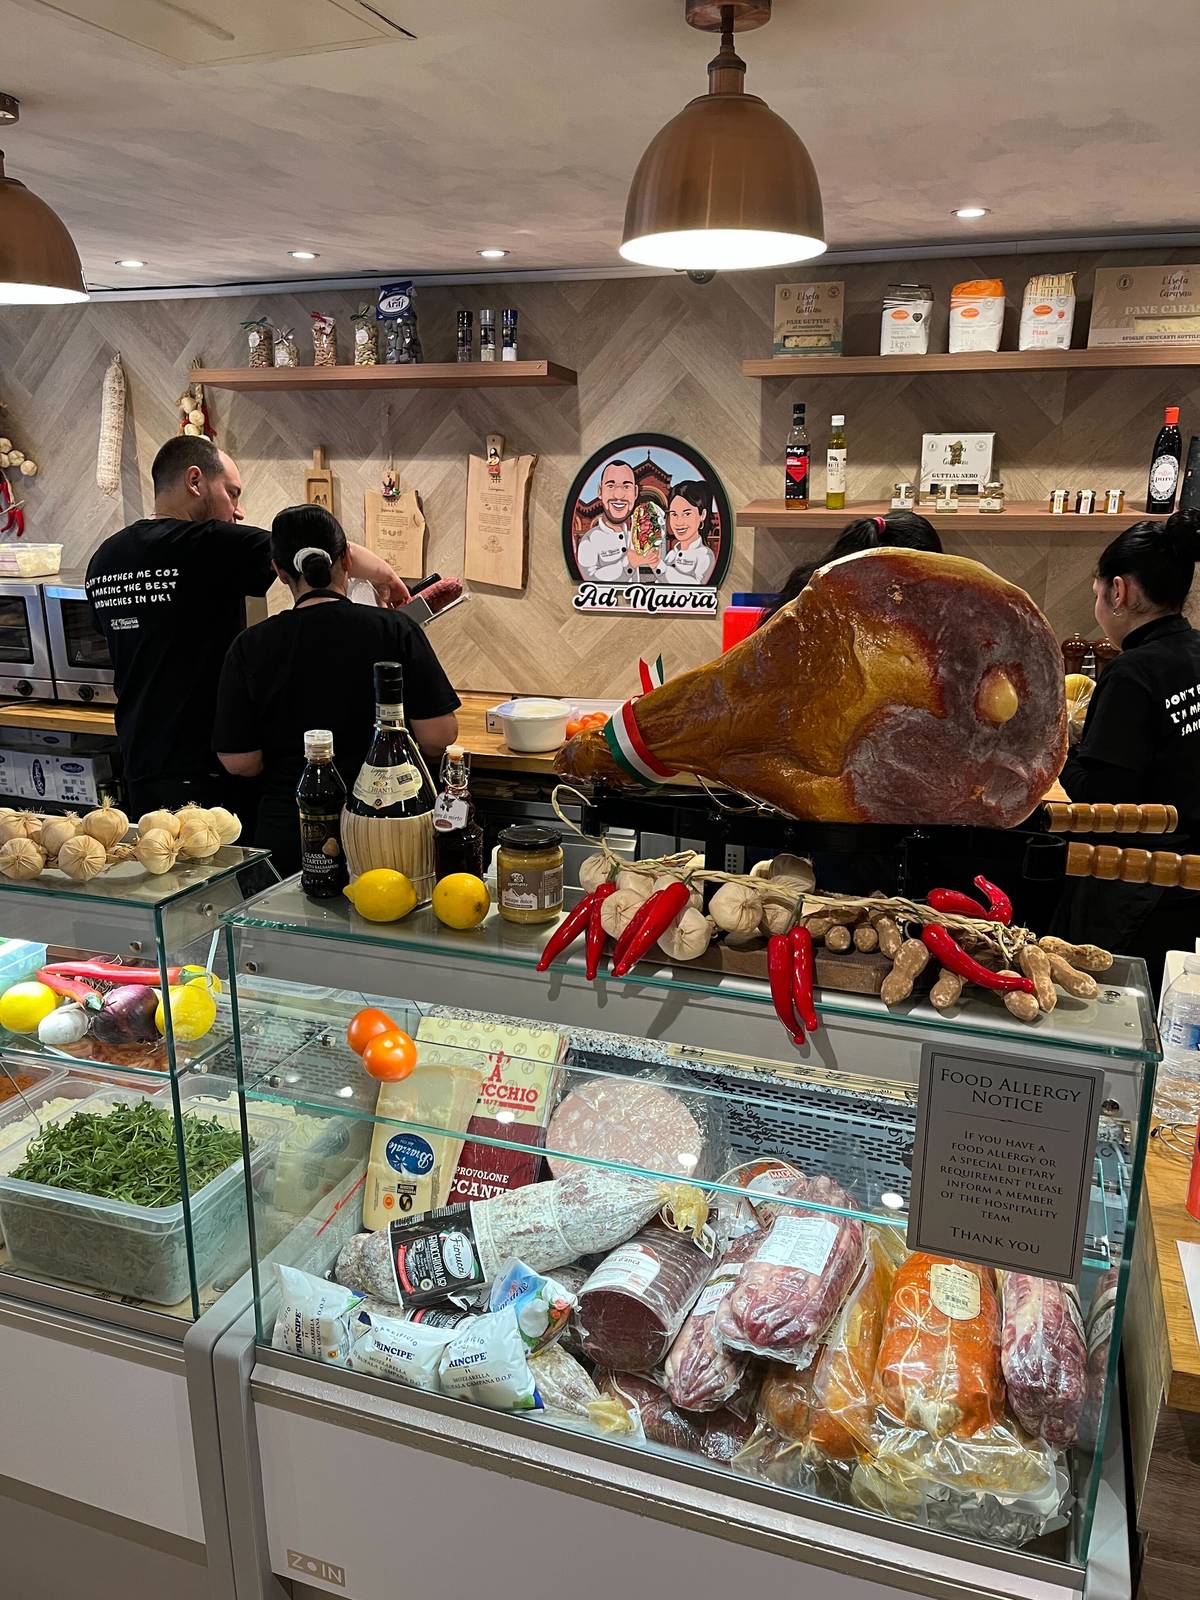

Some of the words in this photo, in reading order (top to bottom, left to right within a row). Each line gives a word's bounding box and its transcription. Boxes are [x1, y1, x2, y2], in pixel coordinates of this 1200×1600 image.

[1125, 306, 1158, 315] PANE
[102, 572, 134, 583] BOTHER
[136, 569, 151, 578] ME
[155, 568, 179, 577] COZ
[95, 585, 121, 597] MAKING
[123, 583, 141, 593] THE
[145, 581, 177, 591] BEST
[135, 595, 147, 604] IN
[574, 584, 617, 607] Ad
[624, 585, 717, 612] Maiora
[1165, 686, 1195, 709] DON'T
[1170, 708, 1187, 724] I'M
[306, 857, 333, 865] TARTUFO
[480, 1083, 539, 1103] ICCHIO
[941, 1068, 993, 1088] FOOD
[998, 1078, 1081, 1103] ALLERGY
[972, 1090, 1044, 1113] NOTICE
[964, 1130, 973, 1140] IF
[977, 1134, 1002, 1145] YOU
[1005, 1139, 1035, 1151] HAVE
[1038, 1144, 1046, 1153] A
[389, 1141, 433, 1168] Brazzale
[951, 1142, 984, 1155] FOOD
[986, 1148, 1035, 1165] ALLERGY
[1039, 1158, 1056, 1168] OR
[949, 1155, 957, 1163] A
[959, 1156, 1003, 1171] SPECIAL
[1007, 1164, 1056, 1180] DIETARY
[940, 1165, 1021, 1188] REQUIREMENT
[1025, 1180, 1064, 1196] PLEASE
[947, 1179, 992, 1195] INFORM
[995, 1188, 1002, 1196] A
[1006, 1190, 1054, 1206] MEMBER
[940, 1190, 953, 1201] OF
[958, 1193, 980, 1205] THE
[984, 1198, 1058, 1220] HOSPITALITY
[950, 1226, 1004, 1247] THANK
[1008, 1239, 1040, 1254] YOU
[450, 1235, 467, 1276] Fiorucci
[295, 1311, 303, 1353] PRINCIPE
[368, 1356, 407, 1375] MOZZARELLA
[449, 1352, 487, 1368] RINCIPE
[379, 1366, 408, 1382] CAMPANA
[466, 1379, 494, 1387] CAMPANA
[290, 1553, 342, 1583] ZOIN
